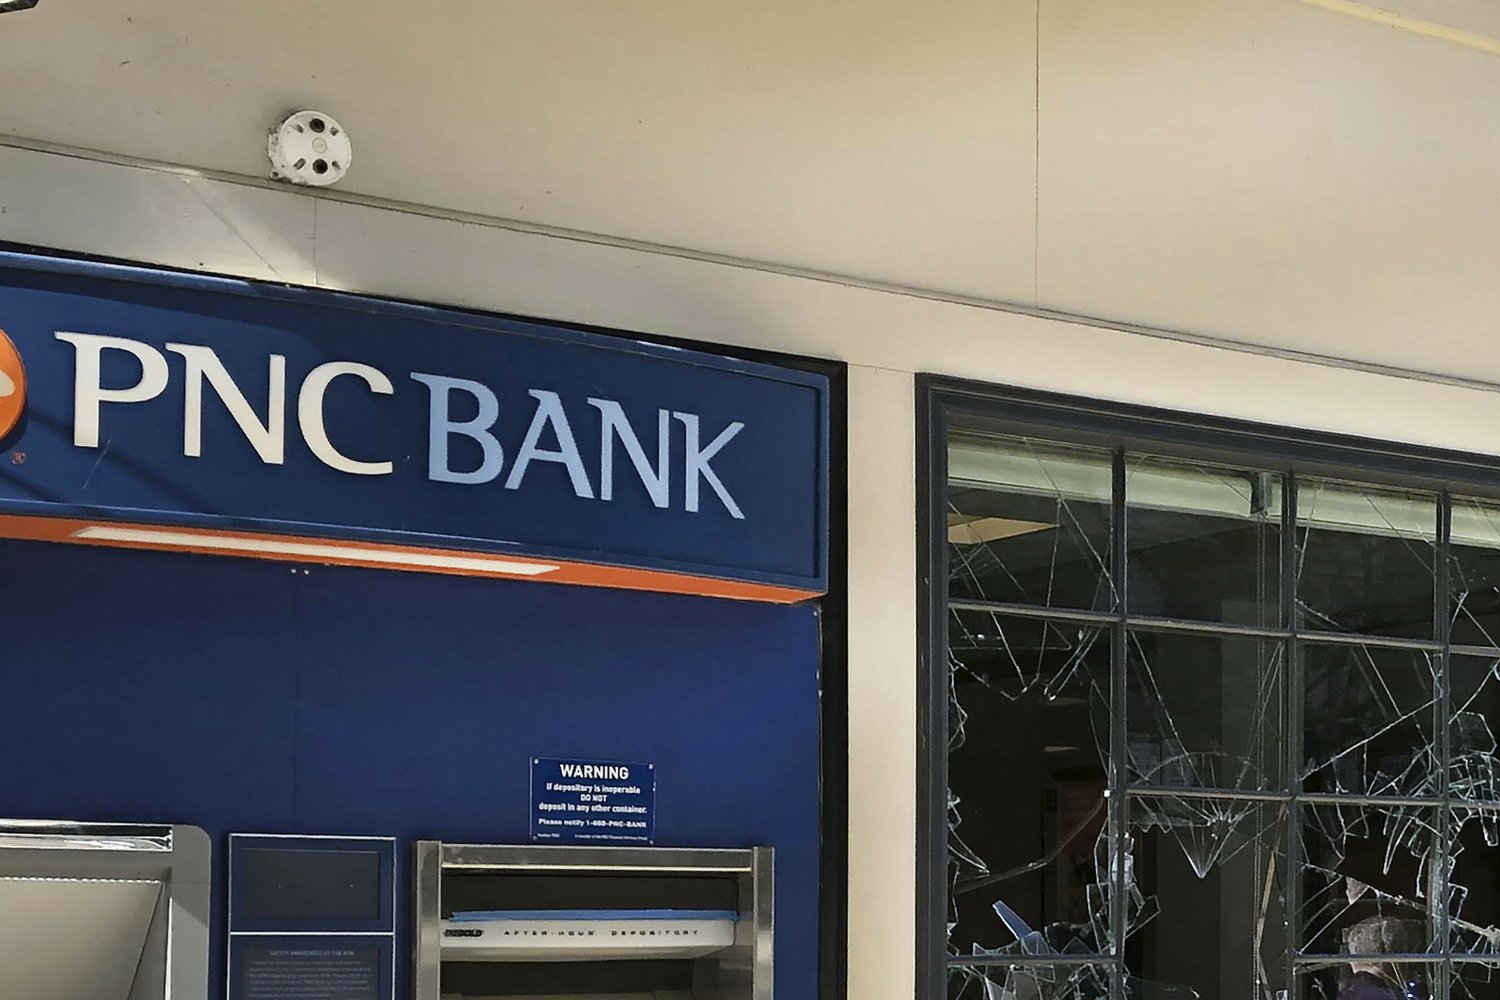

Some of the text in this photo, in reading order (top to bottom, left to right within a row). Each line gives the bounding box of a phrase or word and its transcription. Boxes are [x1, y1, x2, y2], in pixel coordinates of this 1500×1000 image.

[54, 330, 746, 520] PNC BANK
[560, 764, 630, 779] WARNING
[546, 783, 553, 791] If
[553, 784, 593, 793] depository
[602, 785, 641, 795] inoperable
[580, 794, 608, 802] DO NOT
[538, 802, 567, 812] deposit
[567, 803, 576, 811] in
[576, 804, 590, 813] any
[591, 804, 611, 812] other
[563, 819, 585, 828] notify
